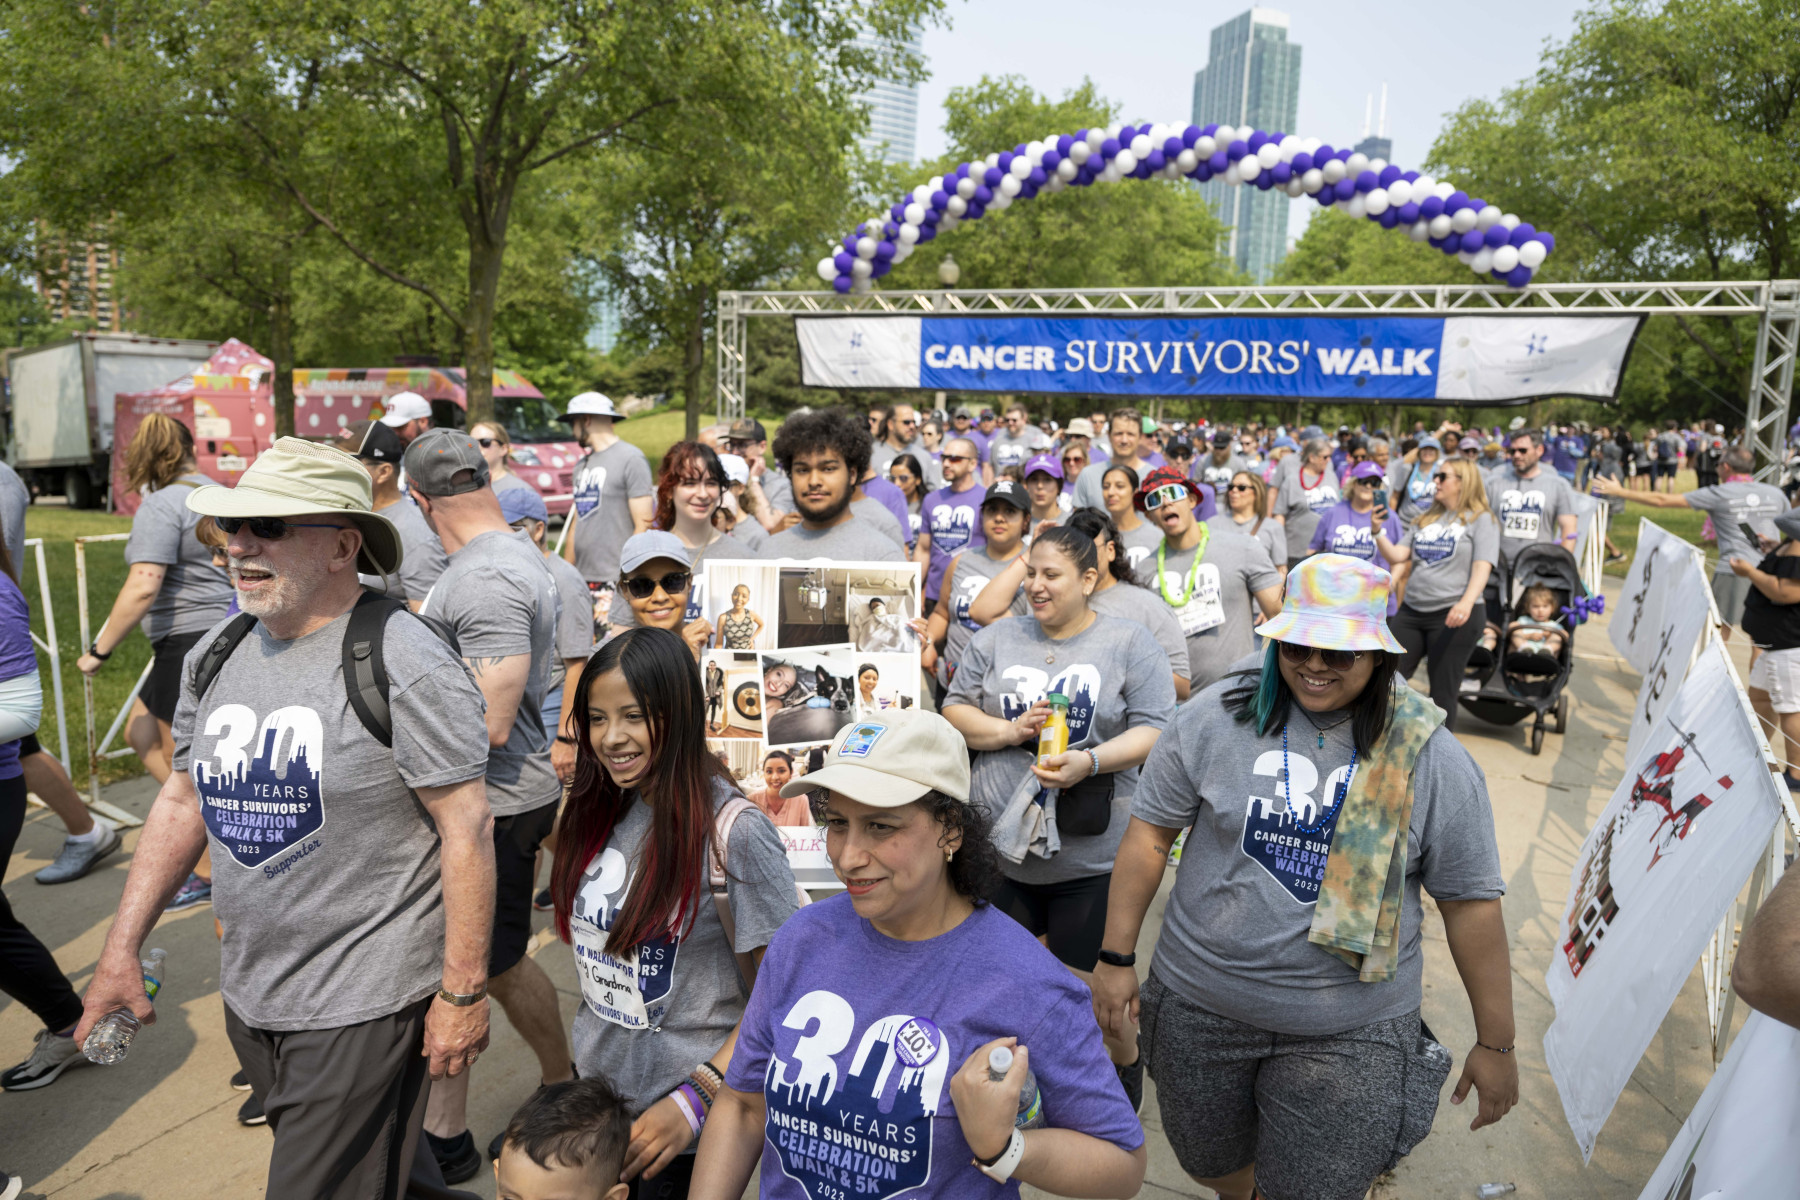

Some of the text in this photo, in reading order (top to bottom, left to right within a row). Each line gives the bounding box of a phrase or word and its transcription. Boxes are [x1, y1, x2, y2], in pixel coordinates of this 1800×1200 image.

[925, 339, 1435, 376] CANCER SURVIVORS' WALK
[931, 504, 975, 530] 30
[1000, 664, 1101, 710] 30
[194, 703, 323, 790] 30
[253, 783, 309, 799] YEARS
[206, 796, 311, 814] CANCER SURVIVORS'
[216, 809, 297, 829] CELEBRATION
[221, 824, 285, 843] WALK & 5K
[1254, 830, 1301, 848] CANCER
[237, 844, 260, 854] 2023
[263, 839, 322, 879] Supporter
[1265, 843, 1328, 868] CELEBRA
[1275, 857, 1325, 881] WALK &
[1294, 879, 1318, 892] 2023
[592, 966, 632, 995] Grandma
[623, 1012, 640, 1026] WALK
[764, 990, 949, 1117] 30
[904, 1030, 926, 1052] 10
[770, 1106, 917, 1163] CANCER SURVIVORS'
[840, 1109, 916, 1144] YEARS
[779, 1129, 897, 1180] CELEBRATION
[790, 1152, 880, 1194] WALK & 5K
[817, 1182, 845, 1200] 2023
